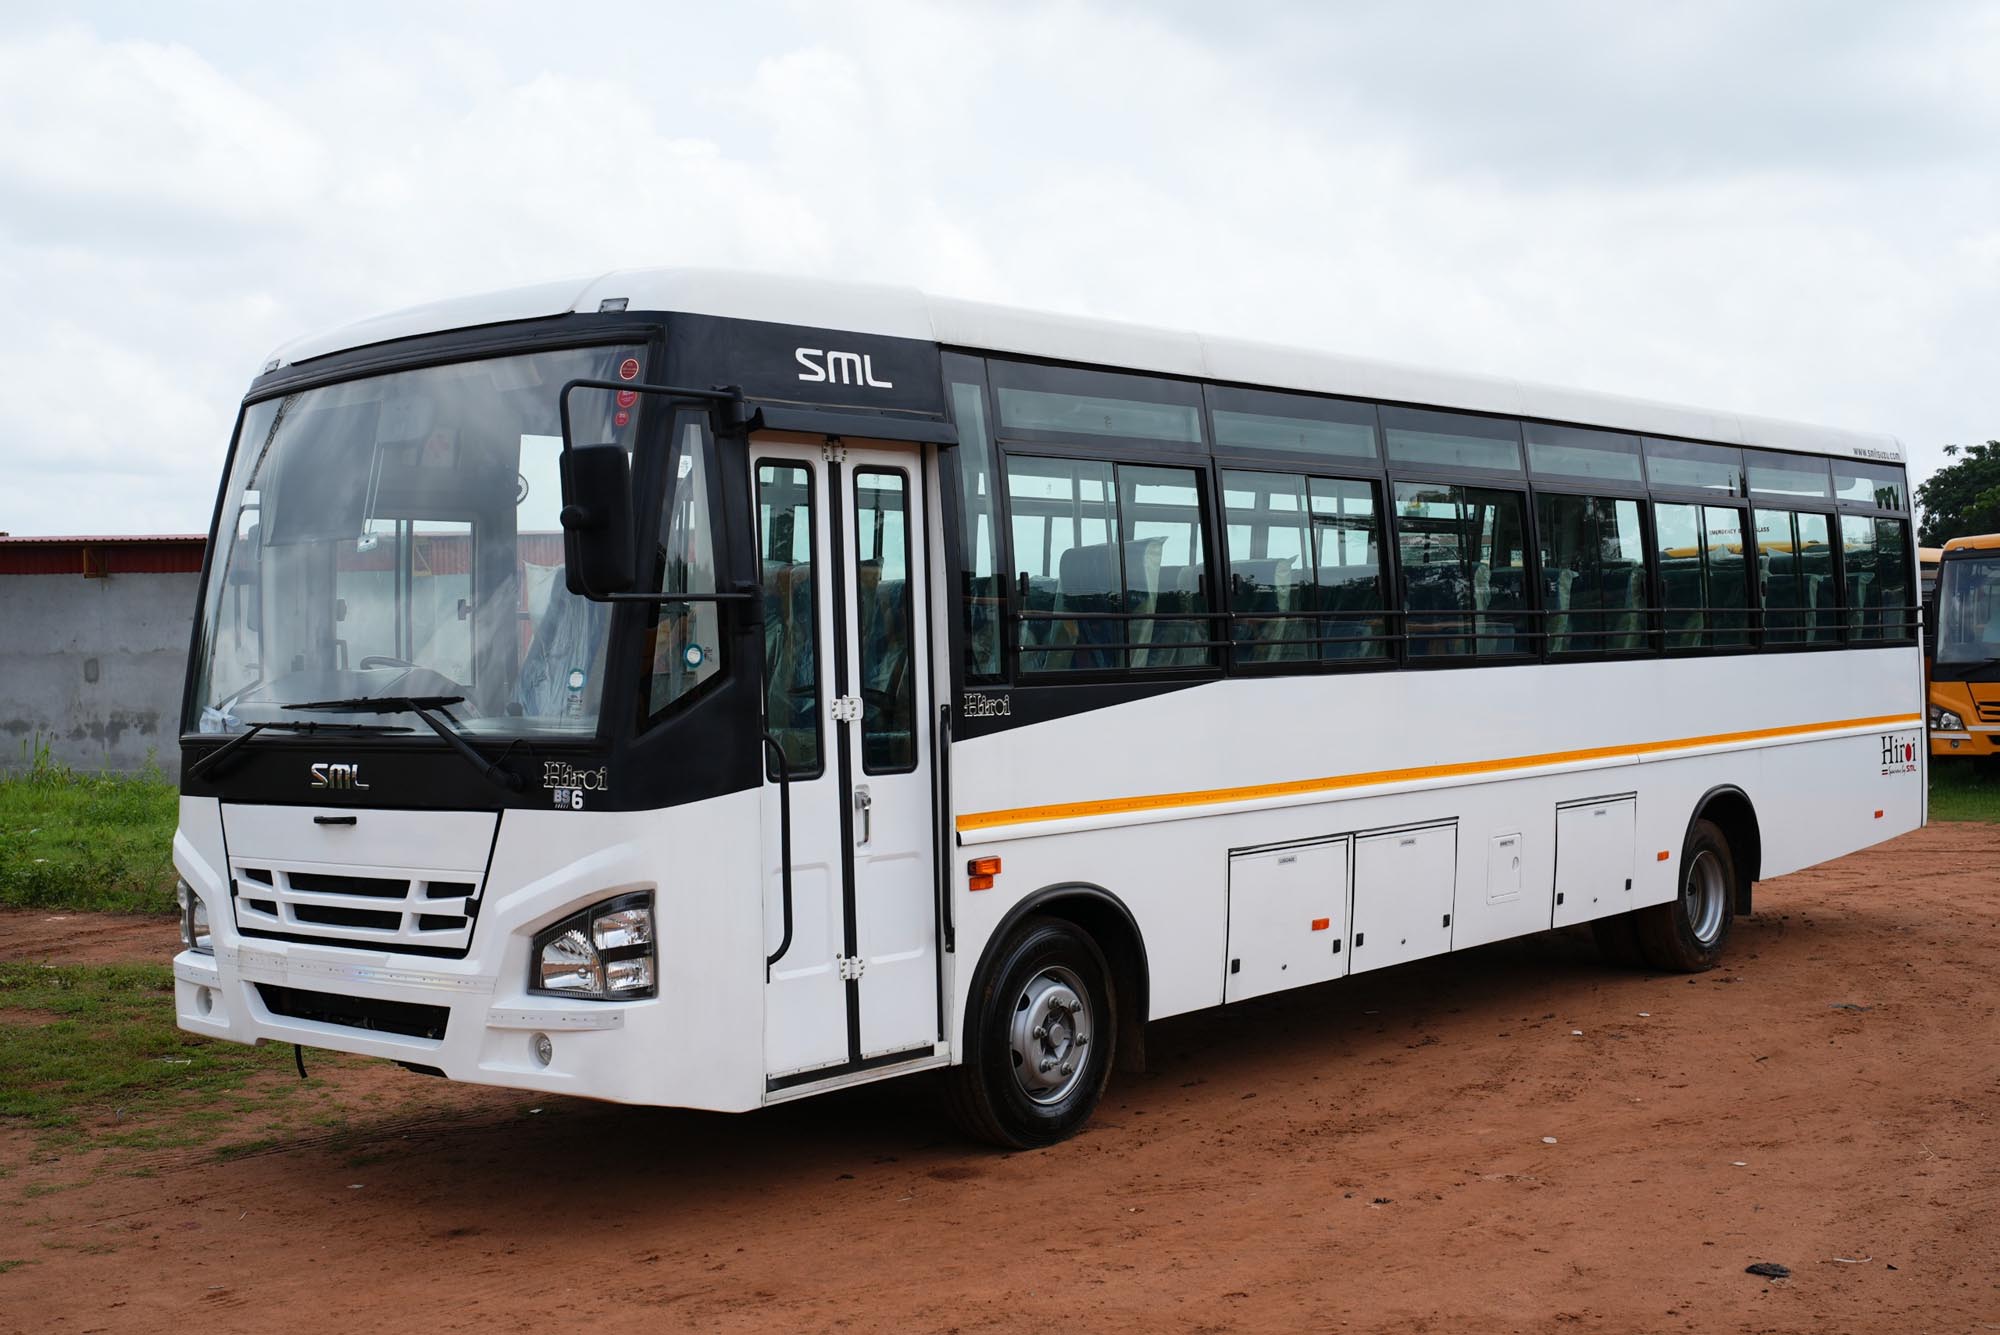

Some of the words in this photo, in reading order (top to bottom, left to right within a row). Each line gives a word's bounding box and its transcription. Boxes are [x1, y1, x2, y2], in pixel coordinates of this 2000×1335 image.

[795, 347, 893, 389] SML
[963, 692, 1012, 717] Hiroi
[1881, 735, 1917, 764] Hiroi
[311, 763, 370, 790] SML
[543, 761, 609, 791] Hiroi
